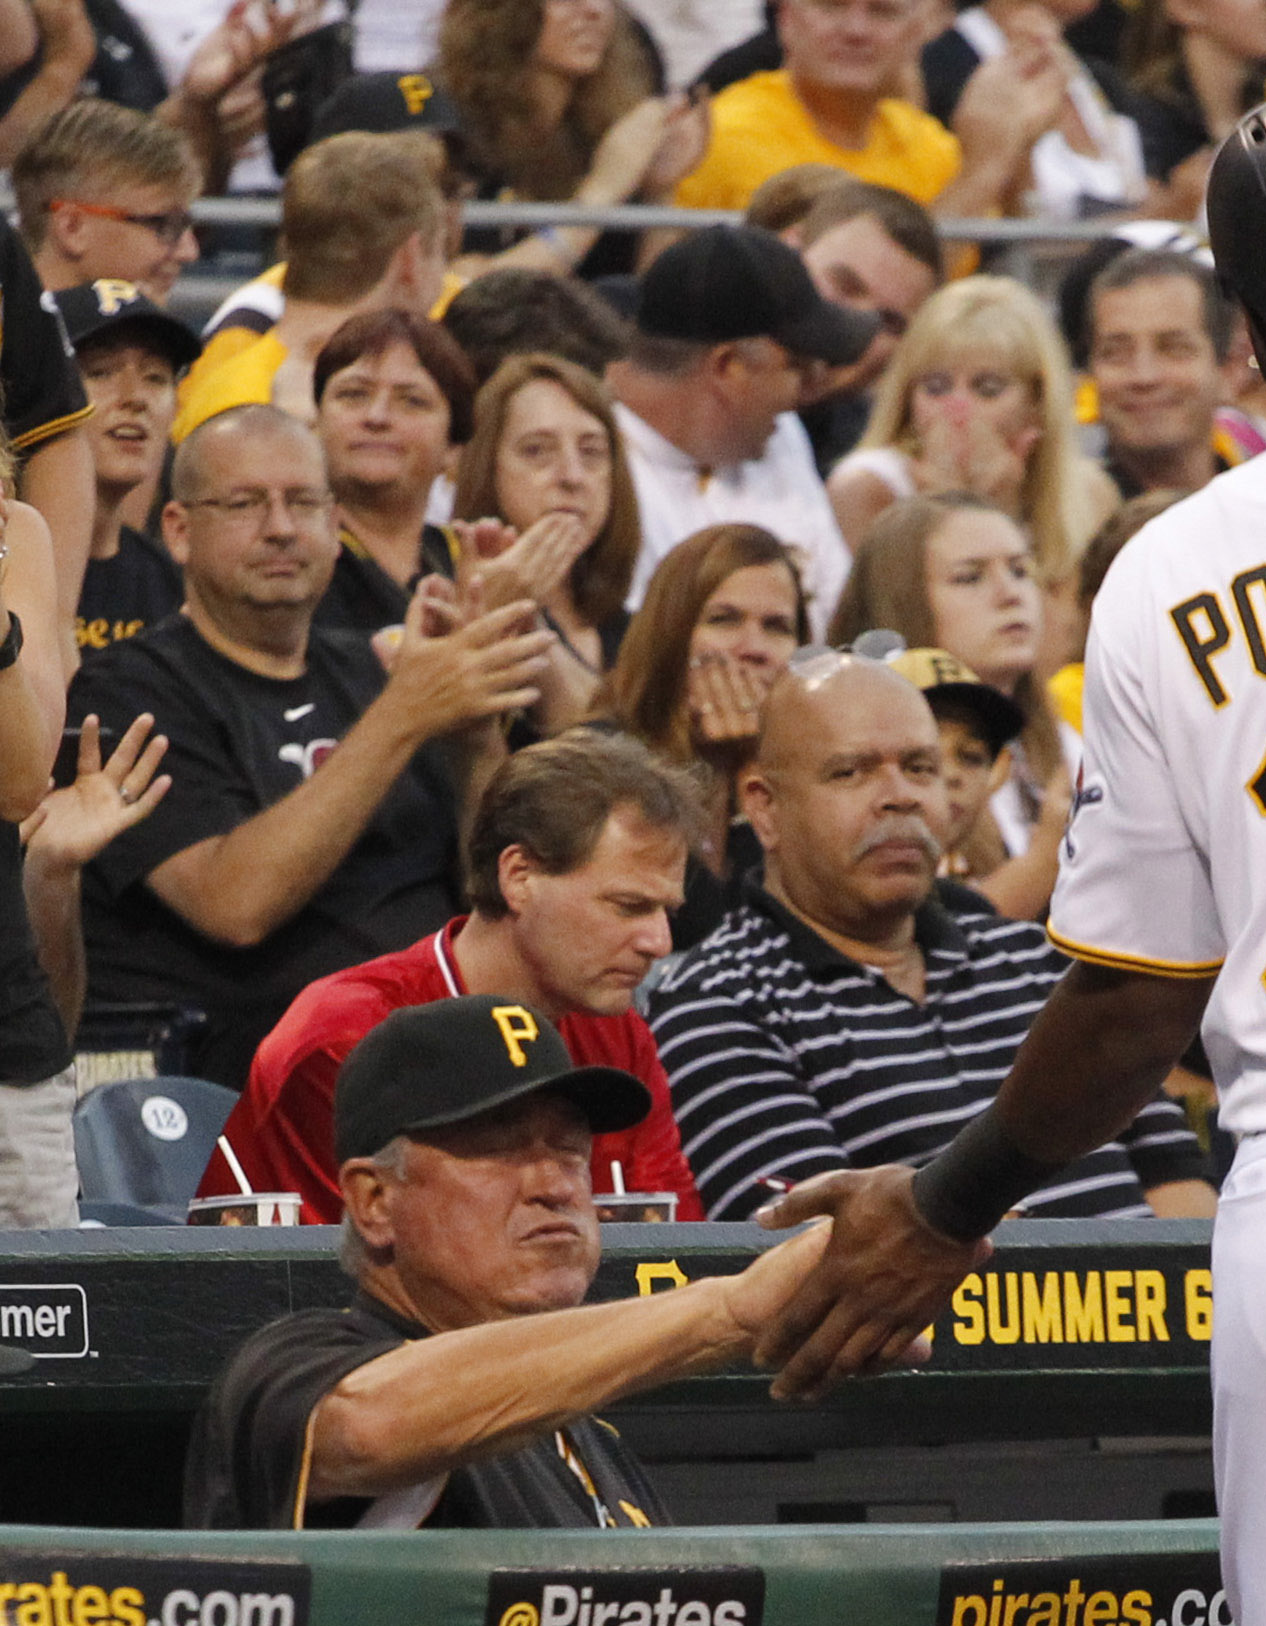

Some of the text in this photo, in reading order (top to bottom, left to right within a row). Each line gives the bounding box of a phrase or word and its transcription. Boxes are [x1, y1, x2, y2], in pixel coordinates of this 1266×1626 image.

[397, 74, 434, 115] P
[92, 279, 137, 315] P
[491, 1005, 539, 1067] P
[153, 1108, 179, 1129] 12
[0, 1305, 71, 1338] mer
[952, 1269, 1212, 1345] SUMMER 6
